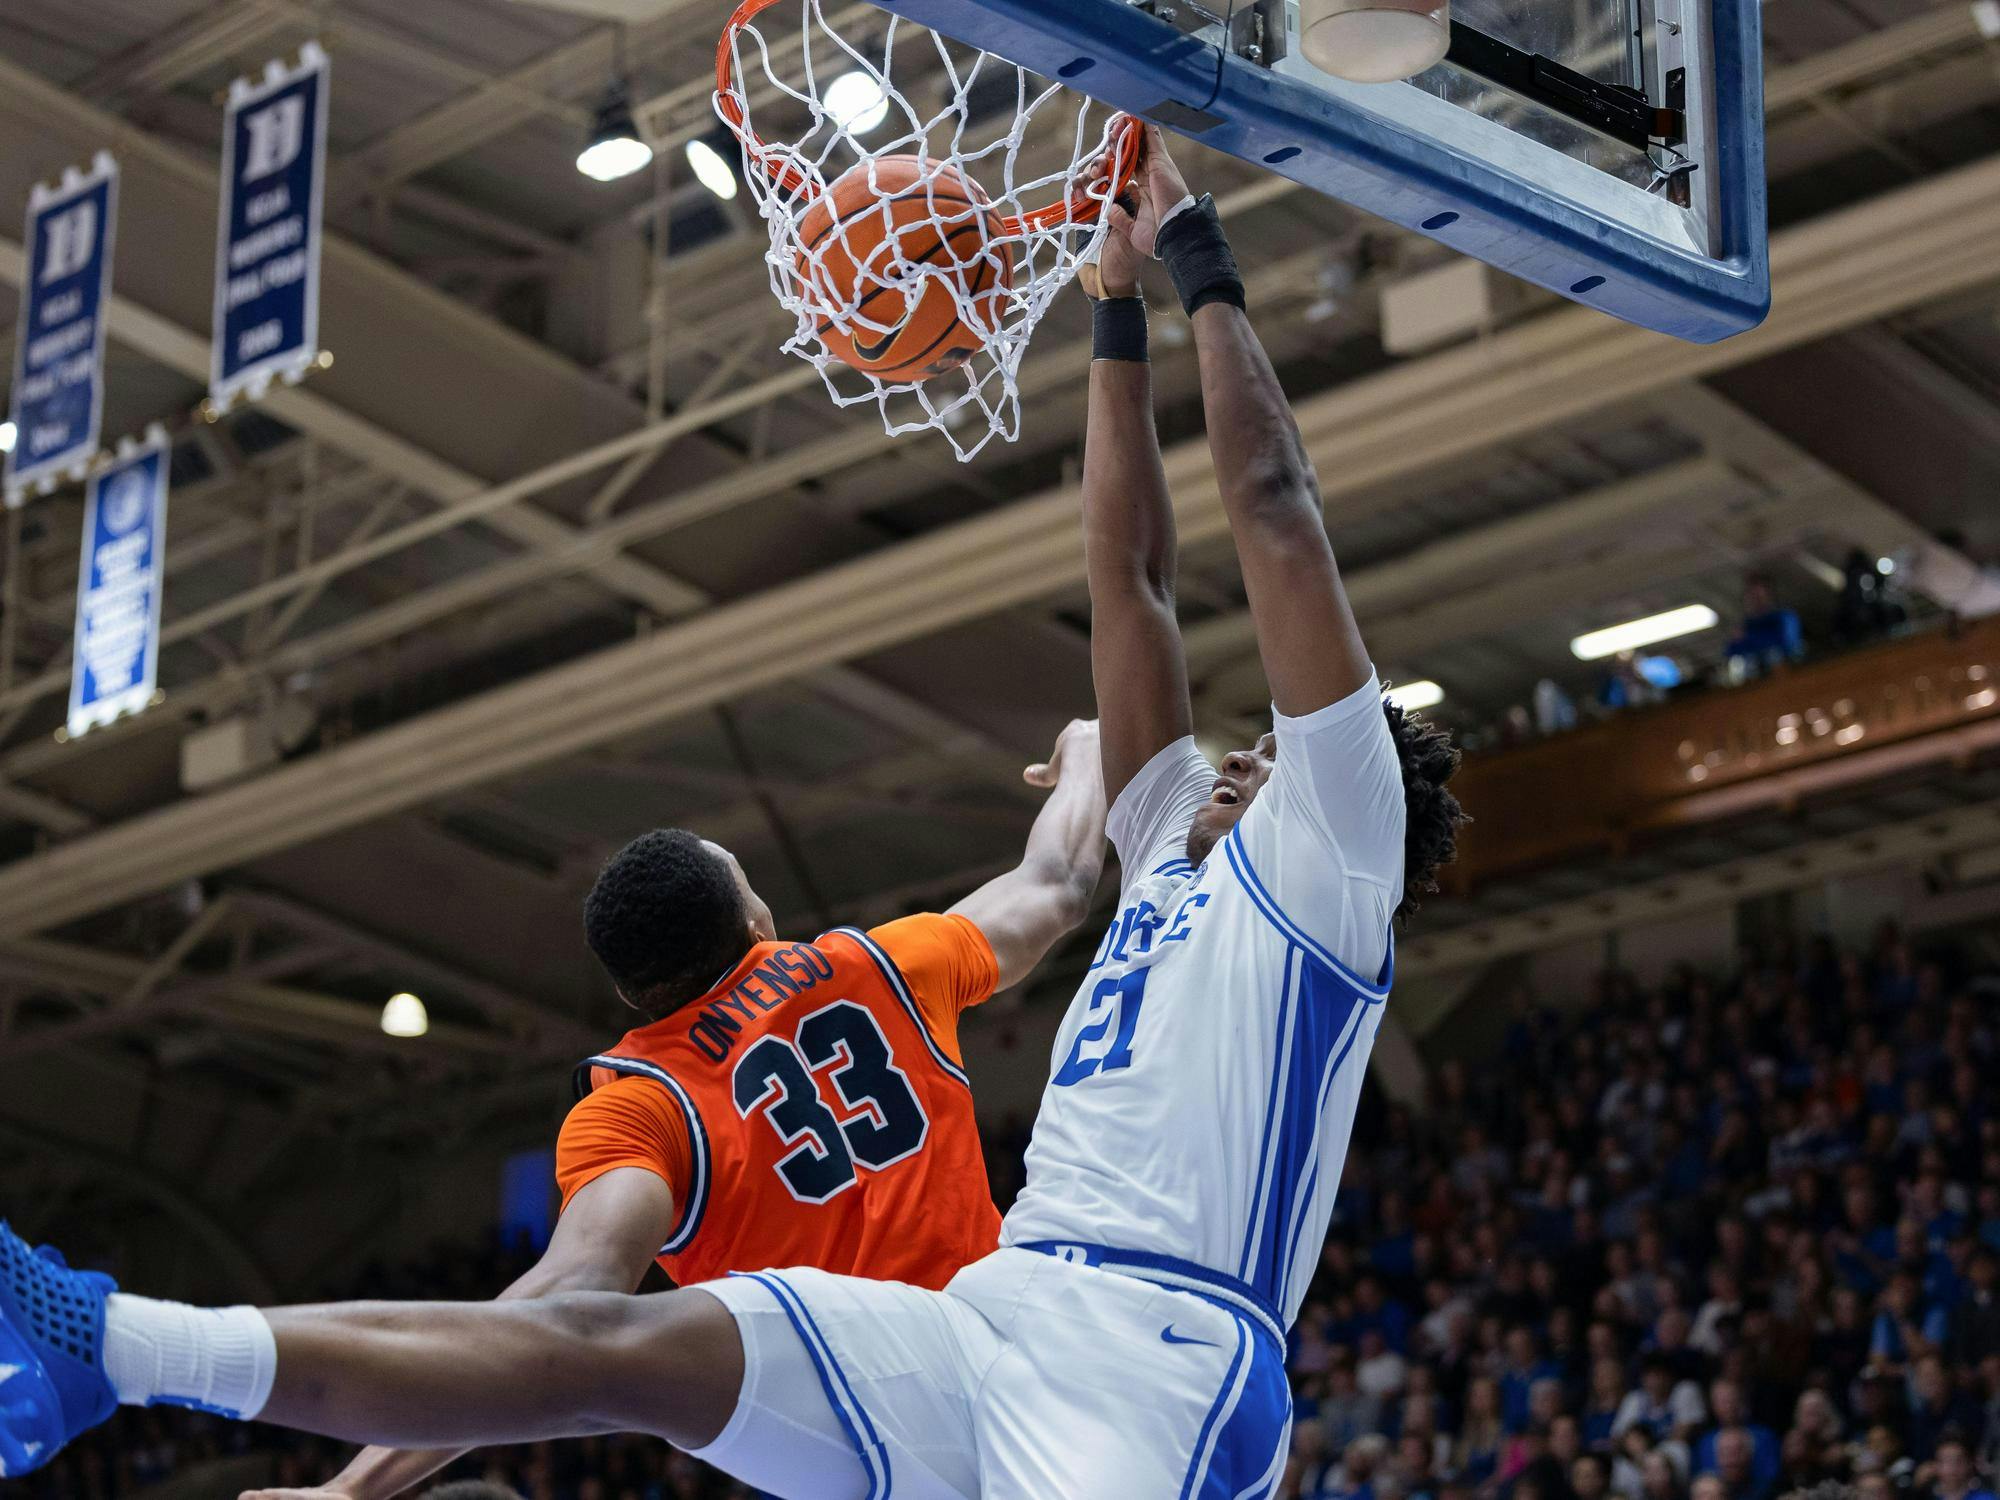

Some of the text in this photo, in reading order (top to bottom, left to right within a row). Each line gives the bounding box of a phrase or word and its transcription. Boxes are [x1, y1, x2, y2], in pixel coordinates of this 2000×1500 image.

[689, 942, 833, 1062] ONYENSO
[1052, 966, 1151, 1086] 21
[732, 999, 930, 1205] 33
